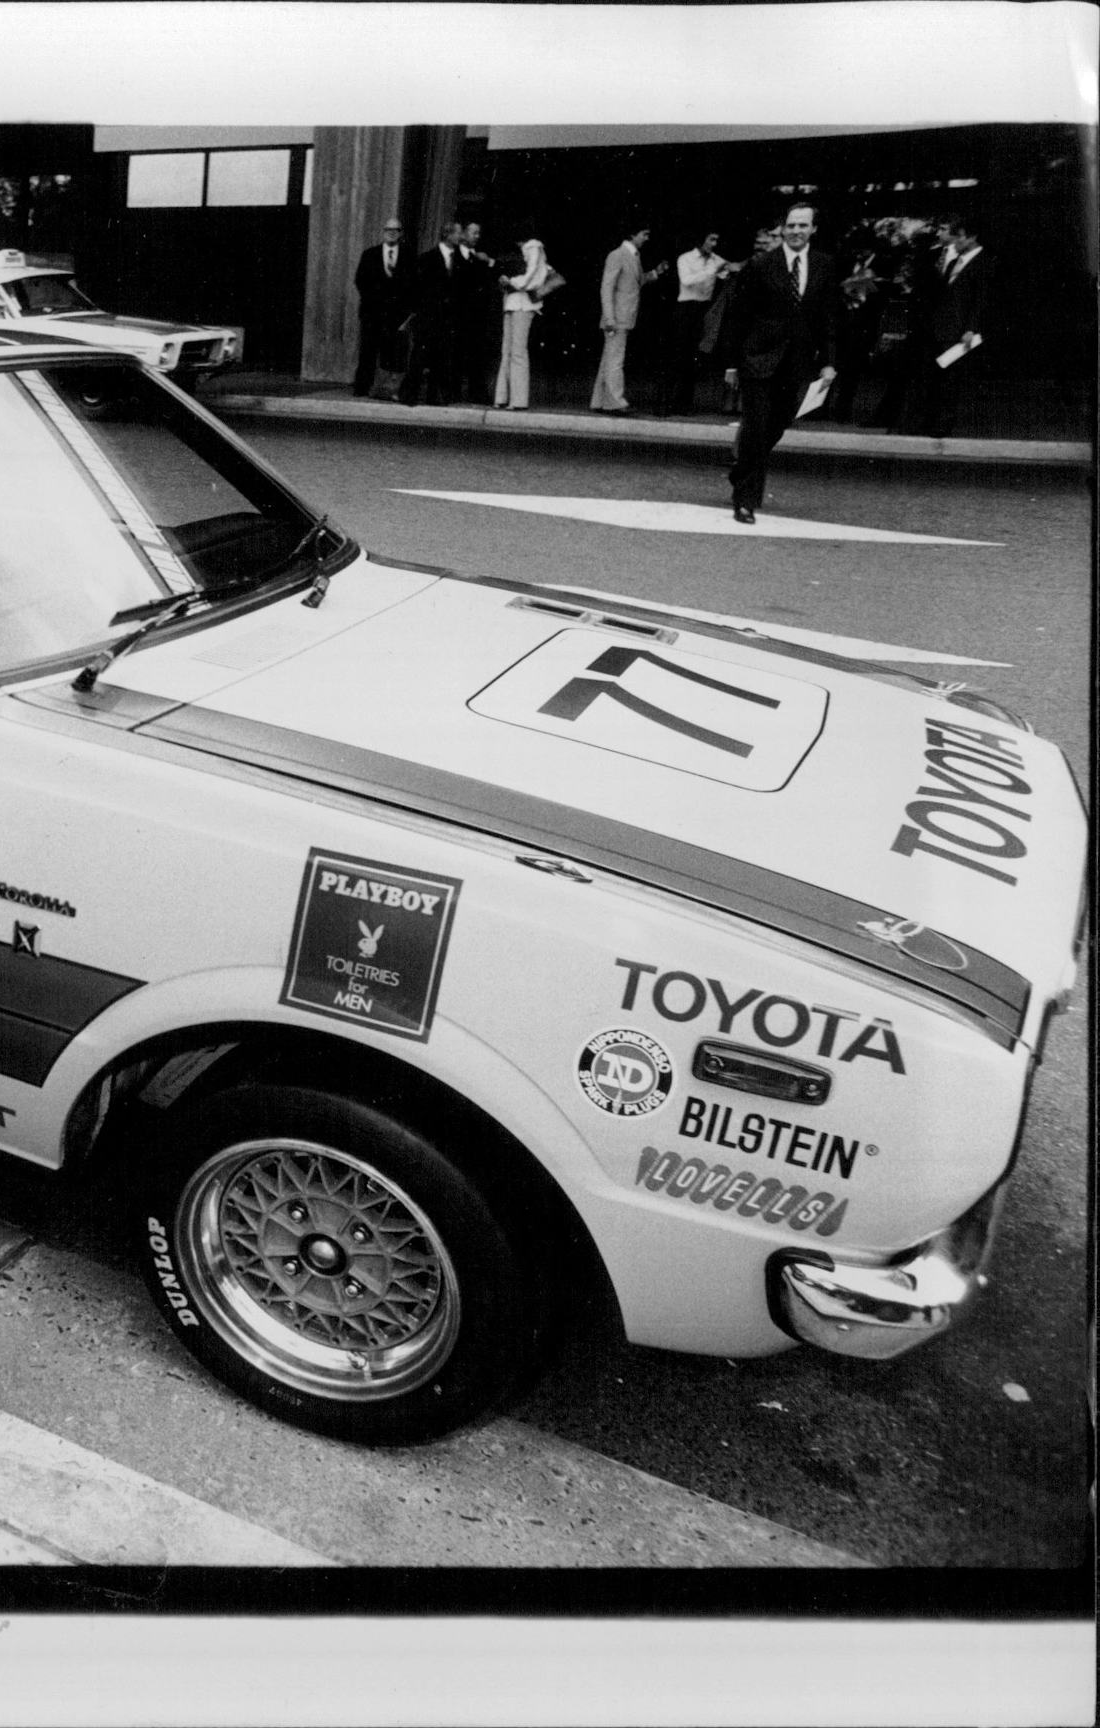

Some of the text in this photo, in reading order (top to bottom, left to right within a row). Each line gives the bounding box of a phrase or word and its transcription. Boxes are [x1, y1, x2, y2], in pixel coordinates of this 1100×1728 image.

[536, 646, 781, 758] 77
[889, 717, 1033, 886] TOYOTA
[319, 871, 440, 916] PLAYBOY
[326, 955, 400, 986] TOILETRIES
[348, 977, 369, 994] for
[333, 991, 373, 1013] MEN
[614, 957, 907, 1075] TOYOTA
[587, 1030, 672, 1074] NIPPONDENSO
[580, 1069, 667, 1115] SPARK PLUGS
[652, 1157, 826, 1223] LOVELLS
[148, 1217, 199, 1326] DUNLOP
